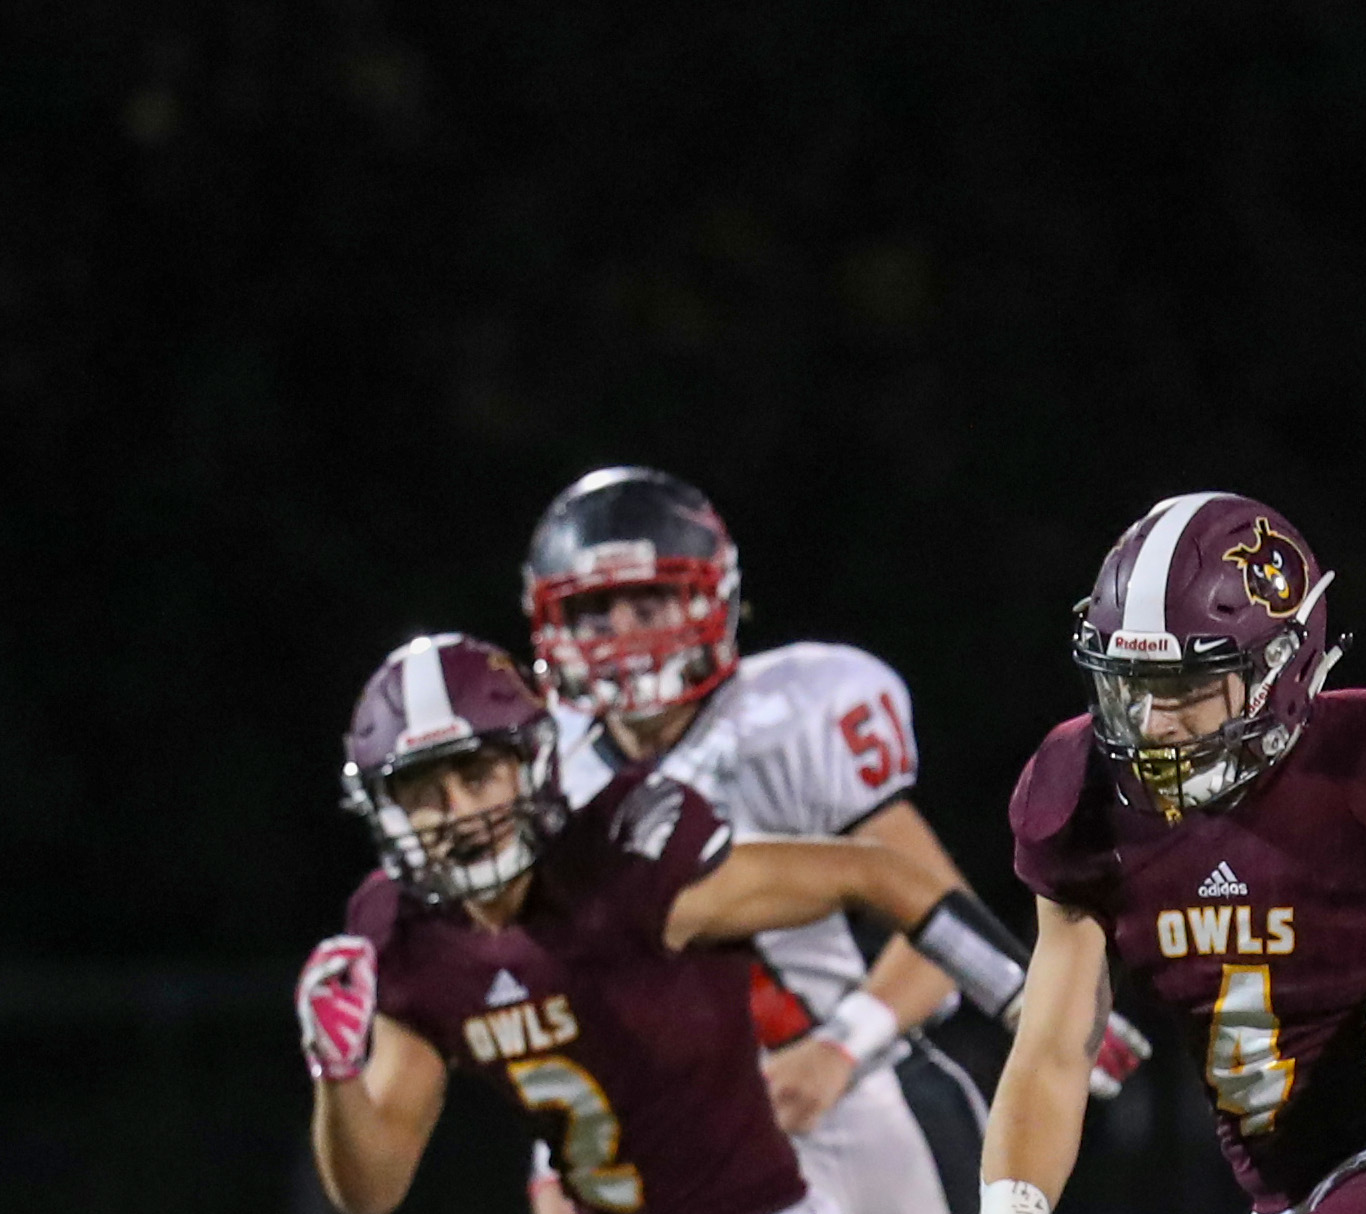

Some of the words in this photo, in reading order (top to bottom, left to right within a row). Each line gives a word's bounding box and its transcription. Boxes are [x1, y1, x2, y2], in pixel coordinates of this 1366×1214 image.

[1115, 637, 1168, 652] Riddell
[839, 692, 910, 788] 51
[1198, 882, 1248, 899] adidas
[1157, 905, 1296, 958] OWLS
[463, 995, 579, 1063] OWLS
[1206, 963, 1296, 1137] 4
[506, 1054, 644, 1214] 2
